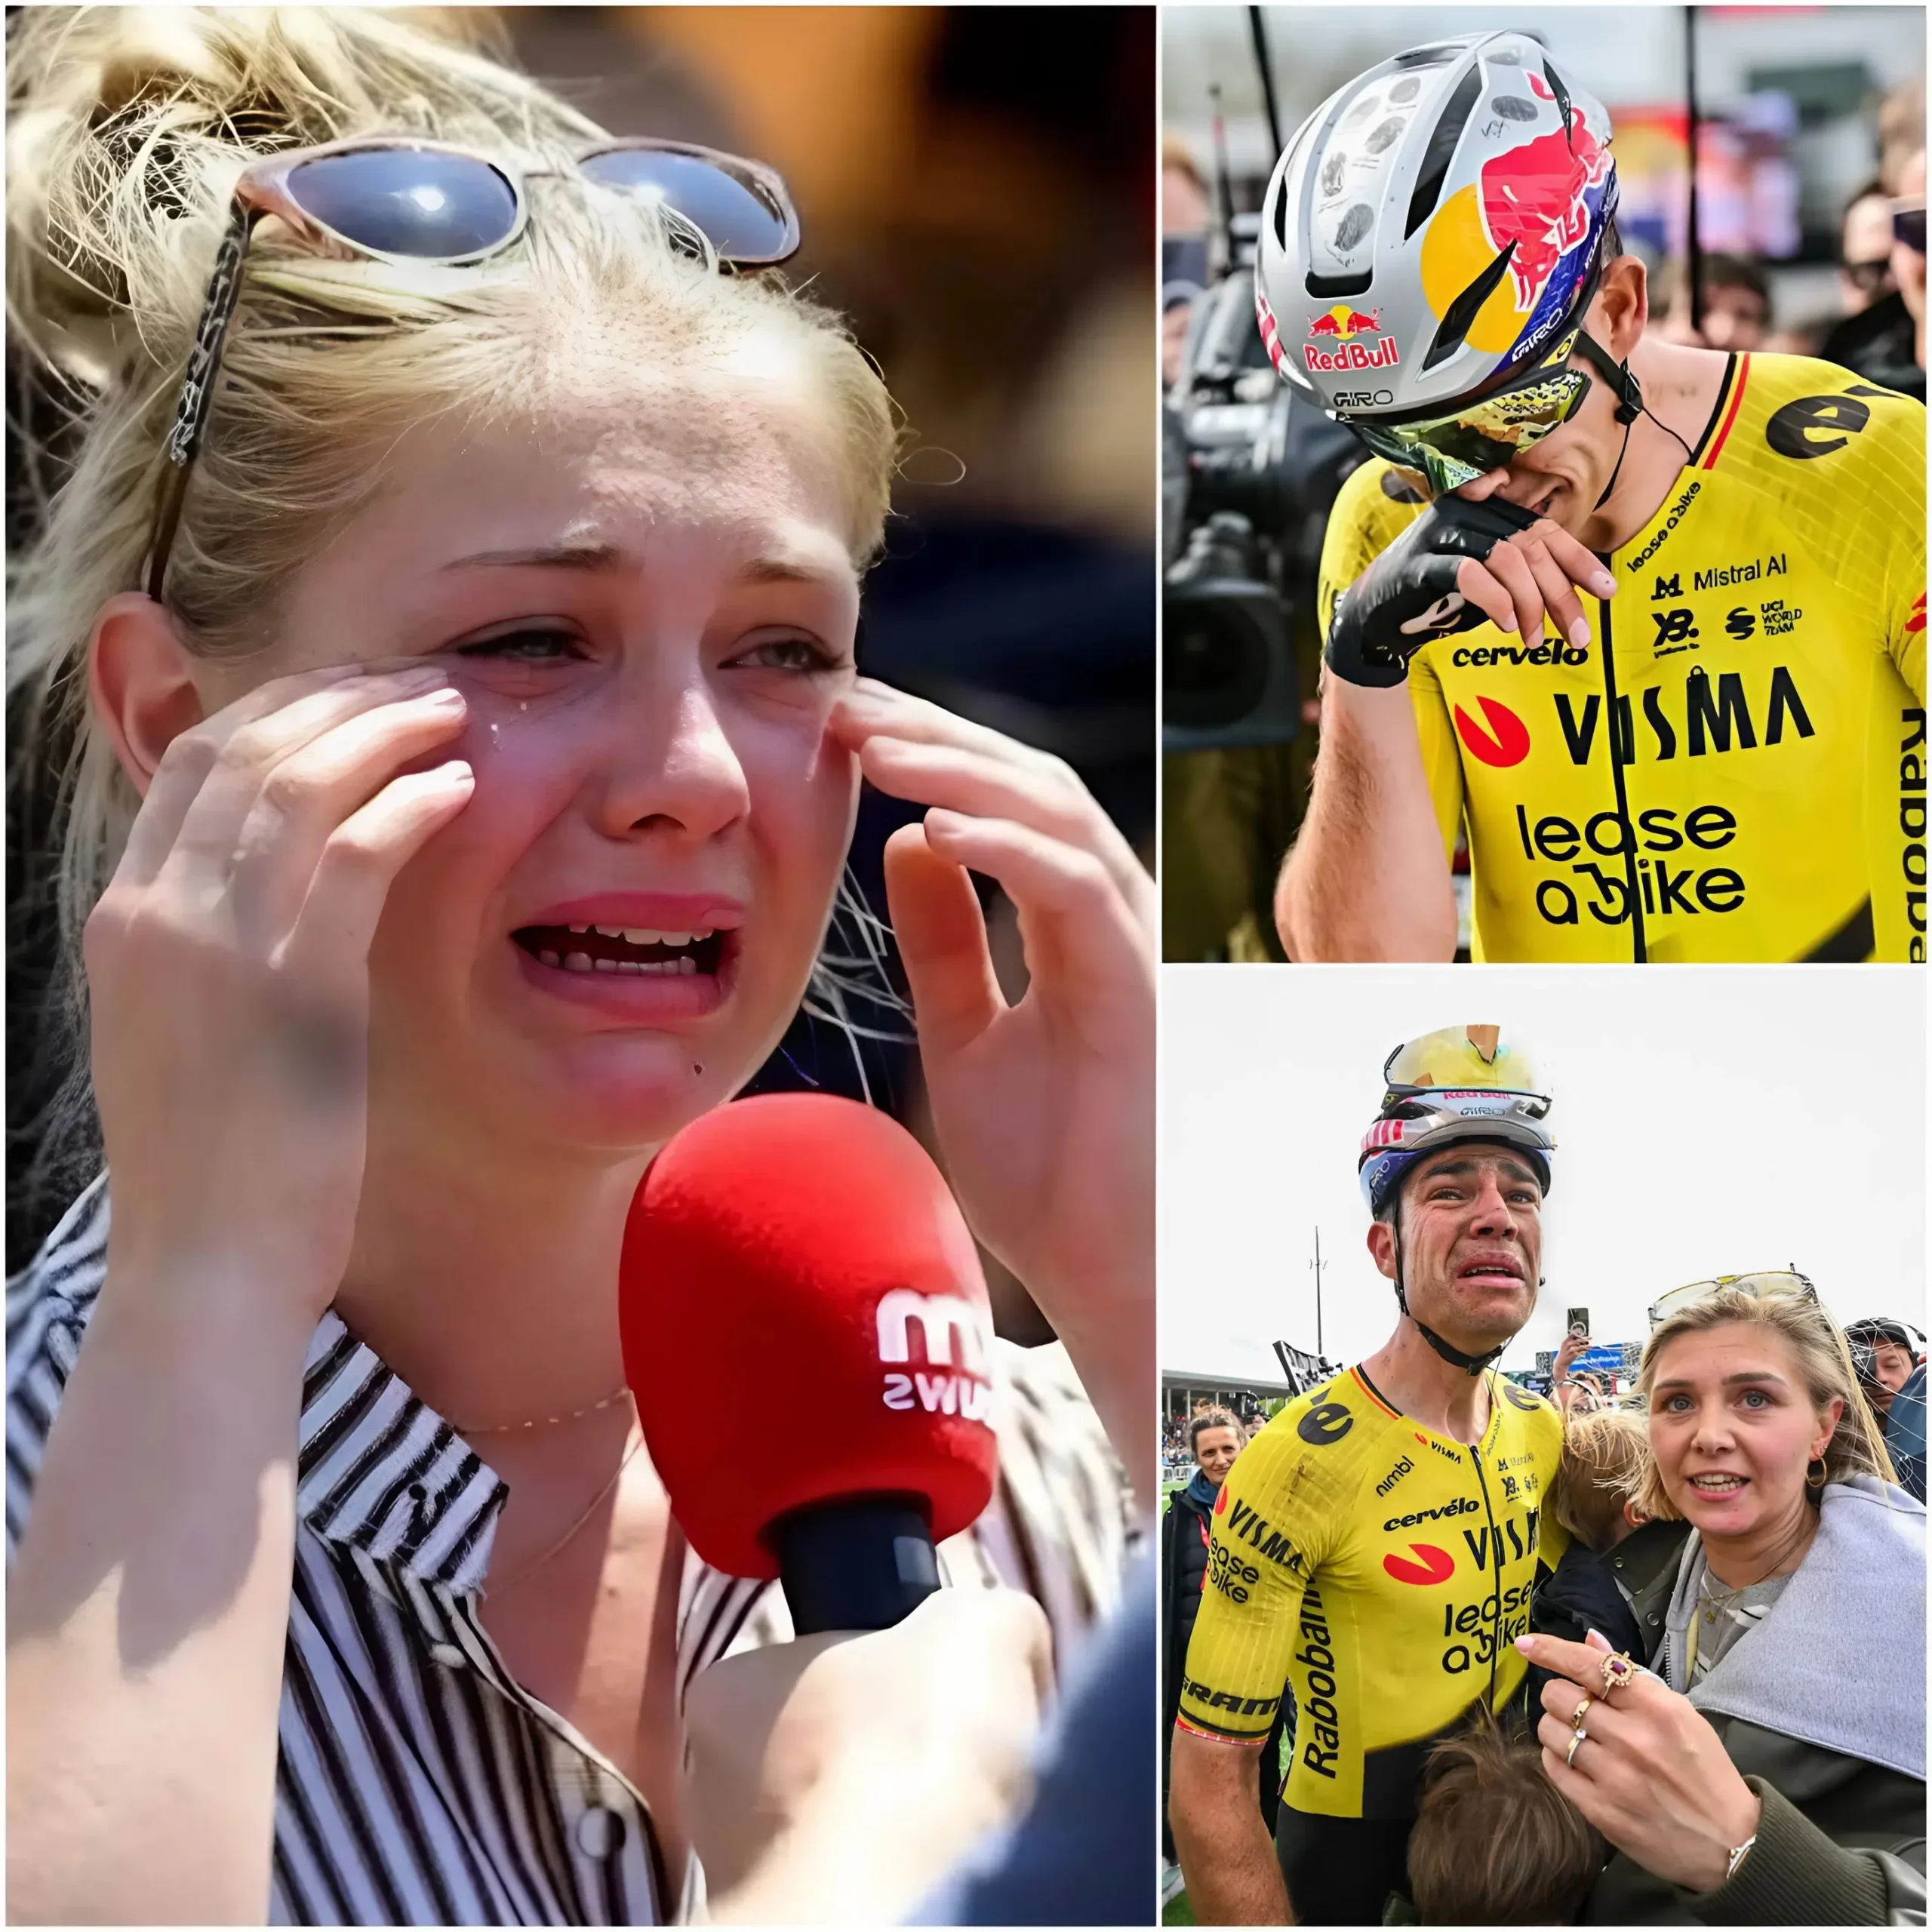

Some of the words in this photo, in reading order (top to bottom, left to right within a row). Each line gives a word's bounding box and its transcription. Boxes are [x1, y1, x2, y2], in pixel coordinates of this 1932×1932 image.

[1333, 389, 1394, 408] GIRO
[1694, 558, 1761, 591] Mistral
[1766, 553, 1787, 577] AI
[1761, 599, 1783, 614] UCI
[1553, 666, 1816, 766] VISMA
[1516, 804, 1737, 862] lease
[1432, 1440, 1461, 1465] VISMA
[1376, 1455, 1415, 1497] nimbl
[1383, 1497, 1480, 1532] cervélo
[1228, 1498, 1303, 1572] VISMA
[1444, 1580, 1533, 1637] lease
